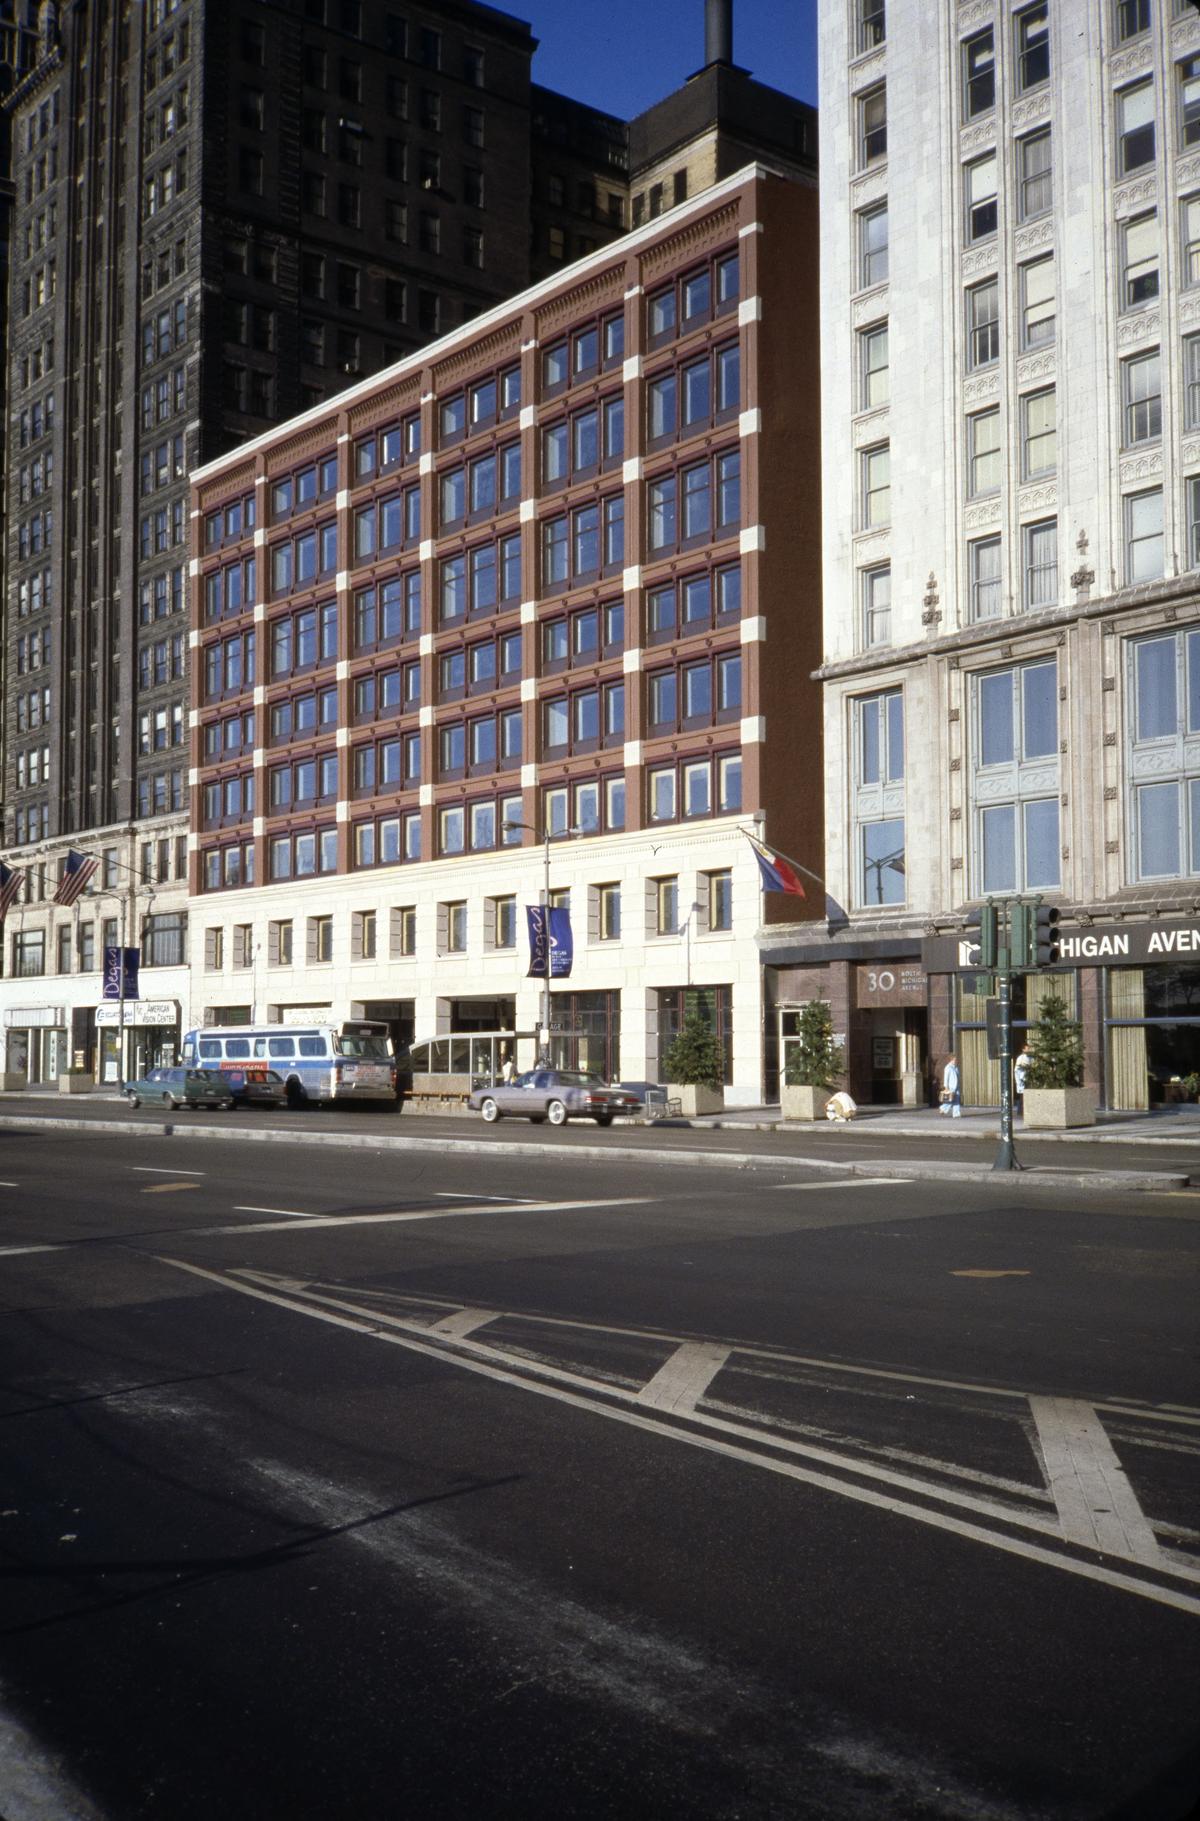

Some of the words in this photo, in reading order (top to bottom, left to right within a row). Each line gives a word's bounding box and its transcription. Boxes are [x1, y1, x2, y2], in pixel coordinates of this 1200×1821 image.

[868, 971, 895, 992] 30
[147, 1003, 170, 1013] AMERICAN
[157, 1013, 175, 1023] CENTER
[536, 1023, 562, 1032] GAGE
